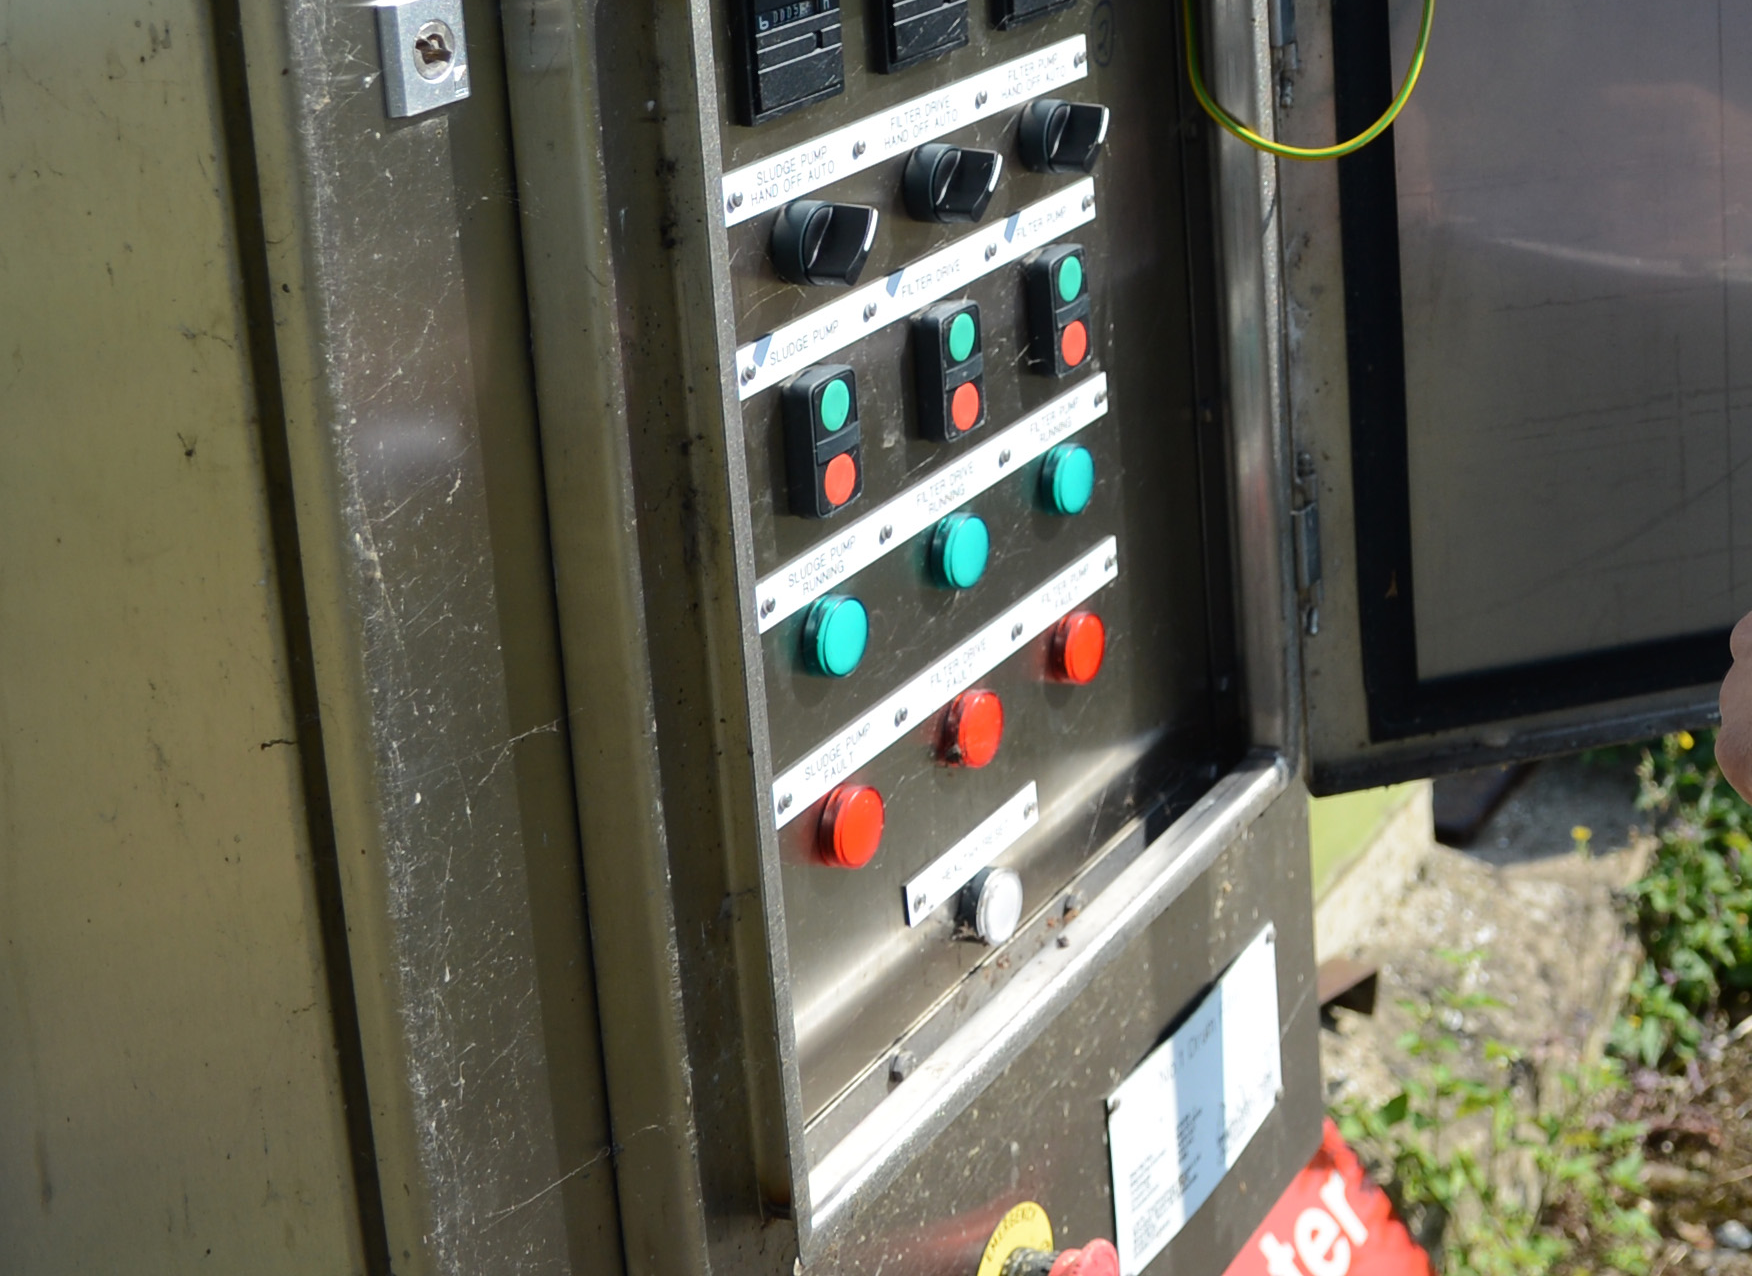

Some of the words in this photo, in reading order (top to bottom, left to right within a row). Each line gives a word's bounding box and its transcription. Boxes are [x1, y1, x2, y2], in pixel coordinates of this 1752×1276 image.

[1008, 61, 1034, 82] FILTER
[1037, 52, 1059, 74] PUMP
[1025, 73, 1041, 91] OFF
[1045, 64, 1066, 85] AUTO
[884, 127, 910, 150] HAND
[913, 118, 930, 140] OFF
[934, 108, 959, 132] AUTO
[890, 107, 921, 130] FILTER
[924, 94, 951, 118] DRIVE
[750, 180, 779, 206] HAND
[783, 171, 804, 194] OFF
[807, 160, 836, 188] AUTO
[756, 162, 797, 187] SLUDGE
[800, 145, 828, 170] PUMP
[1016, 217, 1043, 240] FILTER
[1046, 205, 1068, 228] PUMP
[901, 274, 933, 299] FILTER
[935, 258, 961, 283] DRIVE
[769, 338, 809, 366] SLUDGE
[812, 319, 840, 345] PUMP
[1030, 409, 1056, 434] FILTER
[1057, 396, 1080, 420] PUMP
[916, 477, 948, 507] FILTER
[949, 461, 975, 488] DRIVE
[928, 483, 966, 516] RUNNING
[788, 555, 827, 588] SLUDGE
[830, 534, 857, 562] PUMP
[802, 560, 845, 596] RUNNING
[930, 658, 961, 686] FILTER
[804, 744, 842, 781] SLUDGE
[845, 722, 872, 751] PUMP
[824, 751, 855, 784] FAULT
